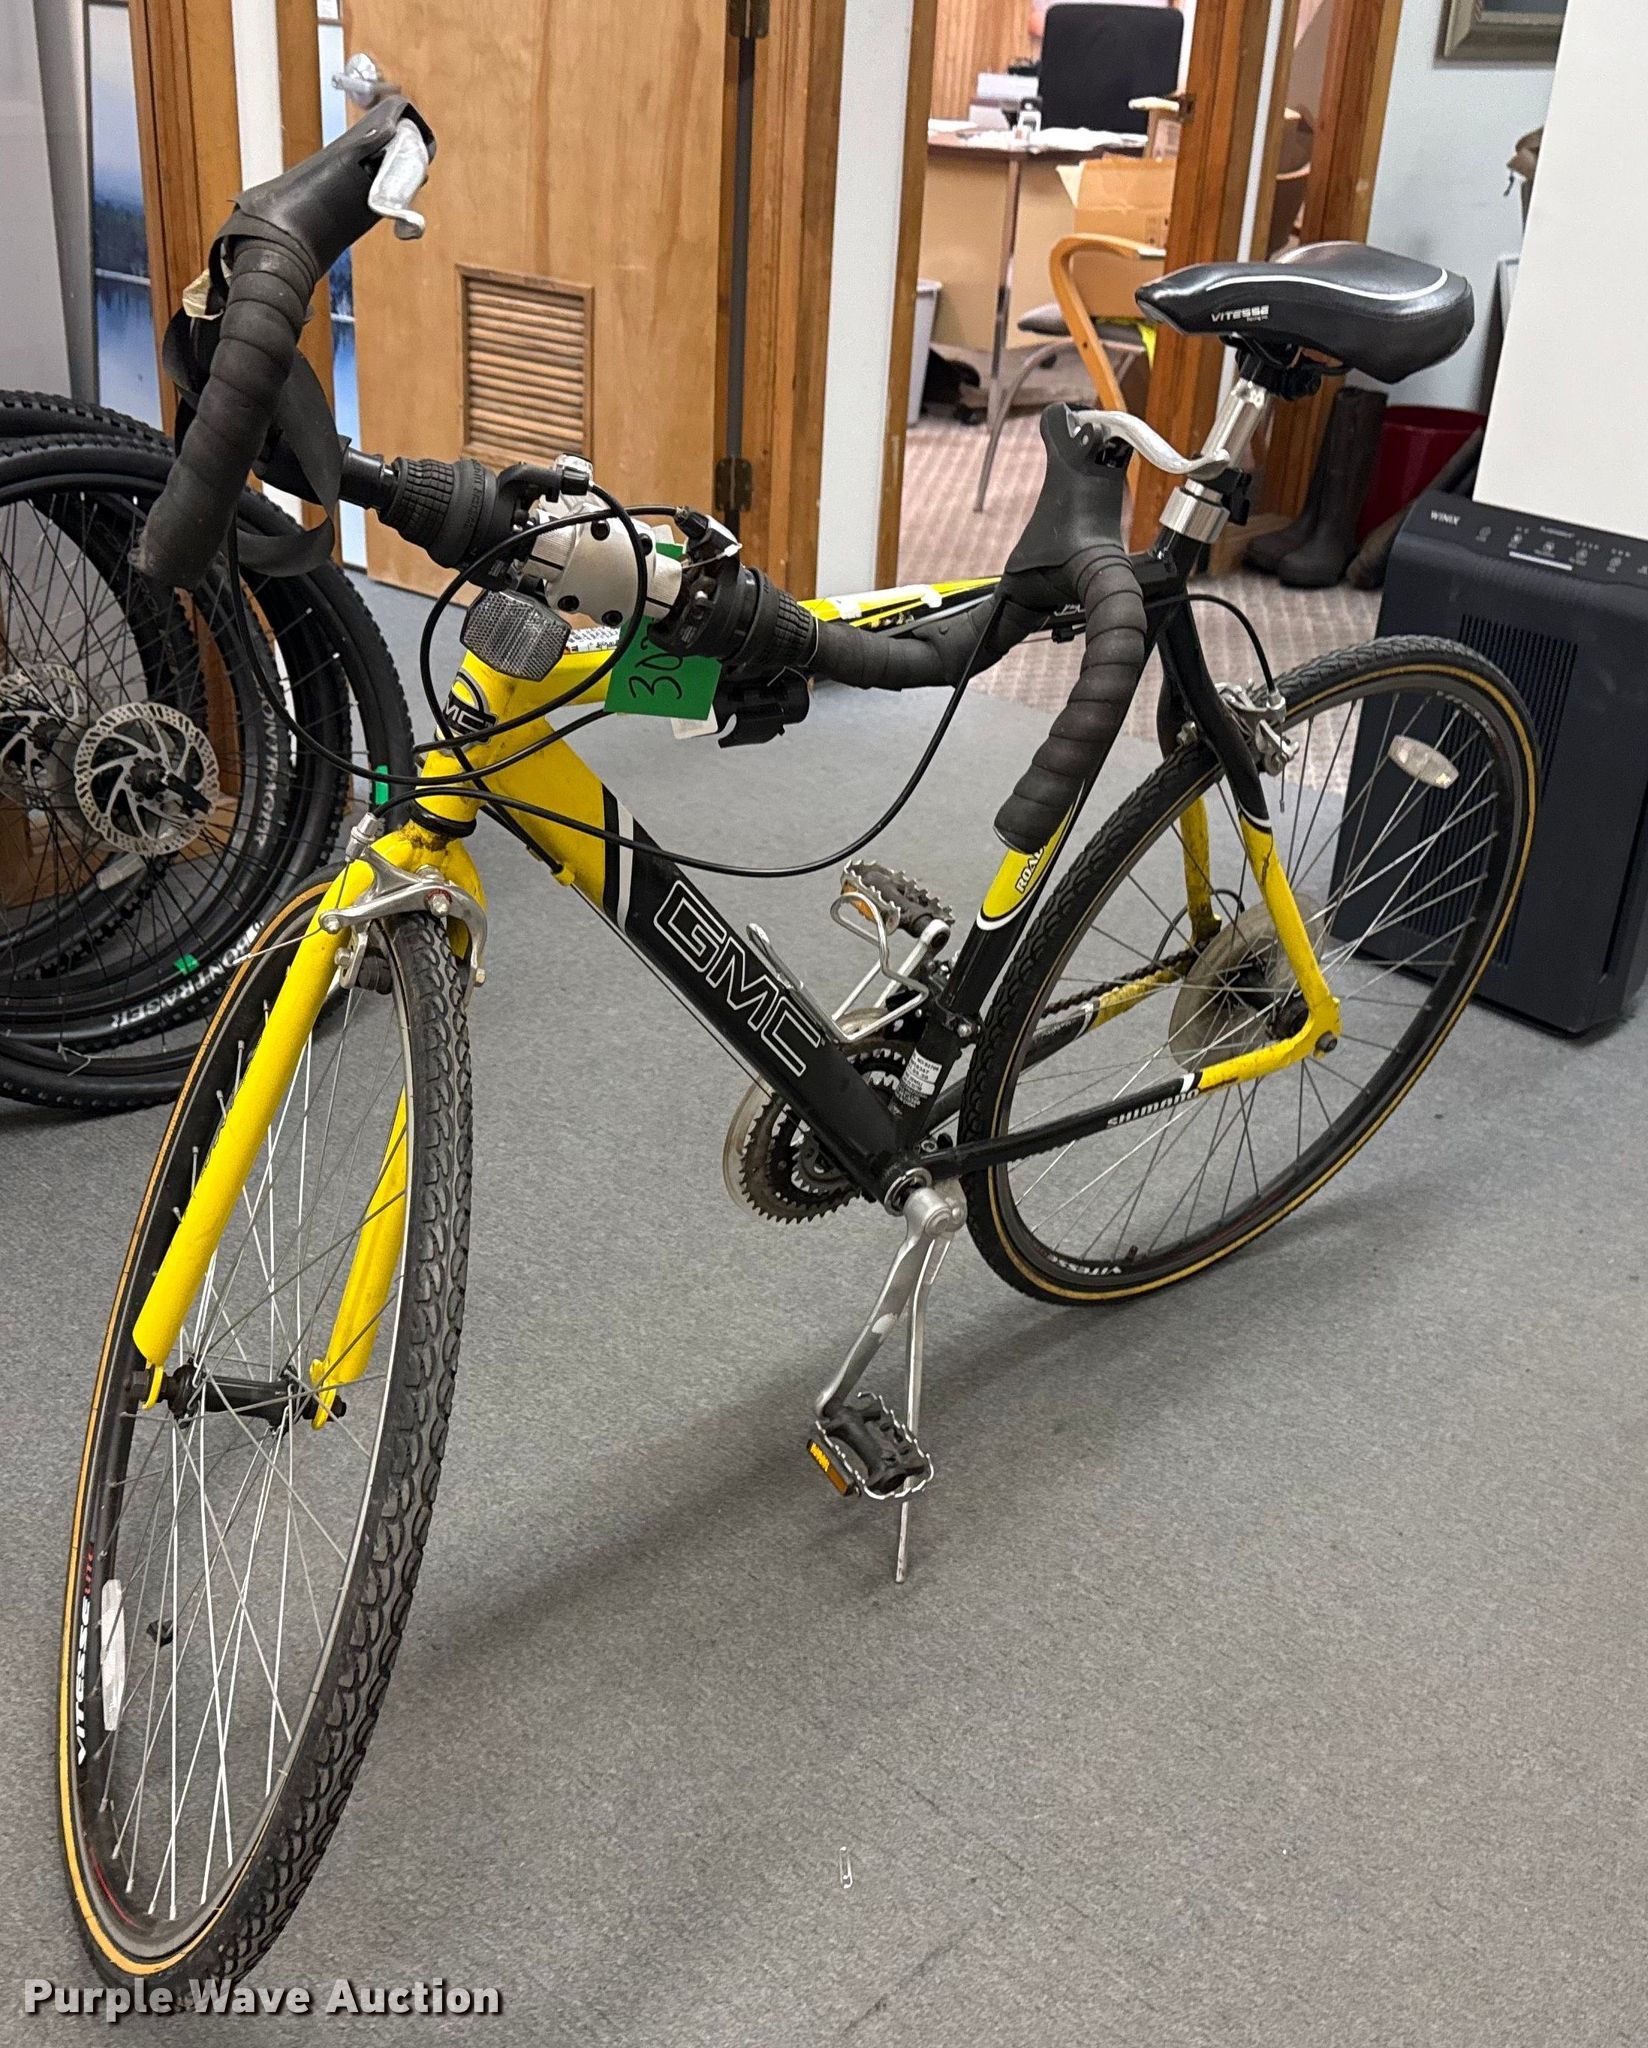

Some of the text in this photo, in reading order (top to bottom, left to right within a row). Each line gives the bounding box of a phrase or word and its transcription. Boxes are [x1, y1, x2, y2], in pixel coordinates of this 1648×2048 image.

[1211, 305, 1269, 322] VITESSE
[253, 688, 280, 849] ONTRAGER
[445, 697, 485, 732] MC
[654, 880, 821, 1078] GMC
[75, 1595, 91, 1766] VITESSE
